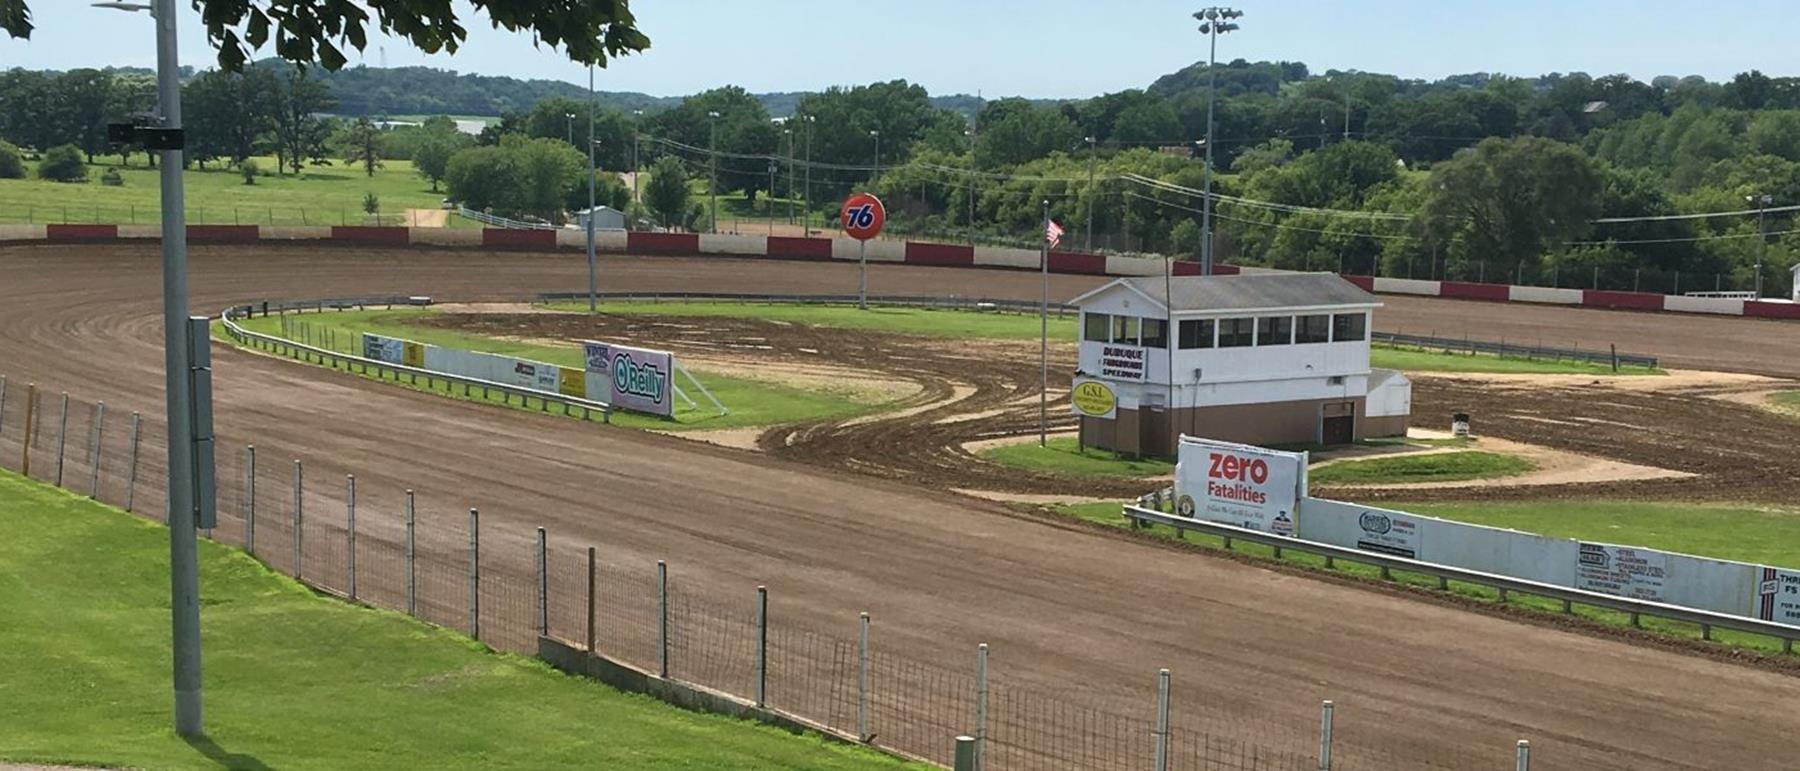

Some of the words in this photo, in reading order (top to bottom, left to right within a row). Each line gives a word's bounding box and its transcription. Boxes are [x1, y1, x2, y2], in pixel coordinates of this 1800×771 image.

[847, 203, 875, 229] 76
[1103, 346, 1143, 359] DUBUQUE
[614, 354, 665, 403] O'Reilly
[1102, 369, 1142, 380] SPEEDWAY
[1208, 453, 1269, 485] zero
[1208, 481, 1266, 504] Fatalities
[1785, 585, 1798, 594] FS
